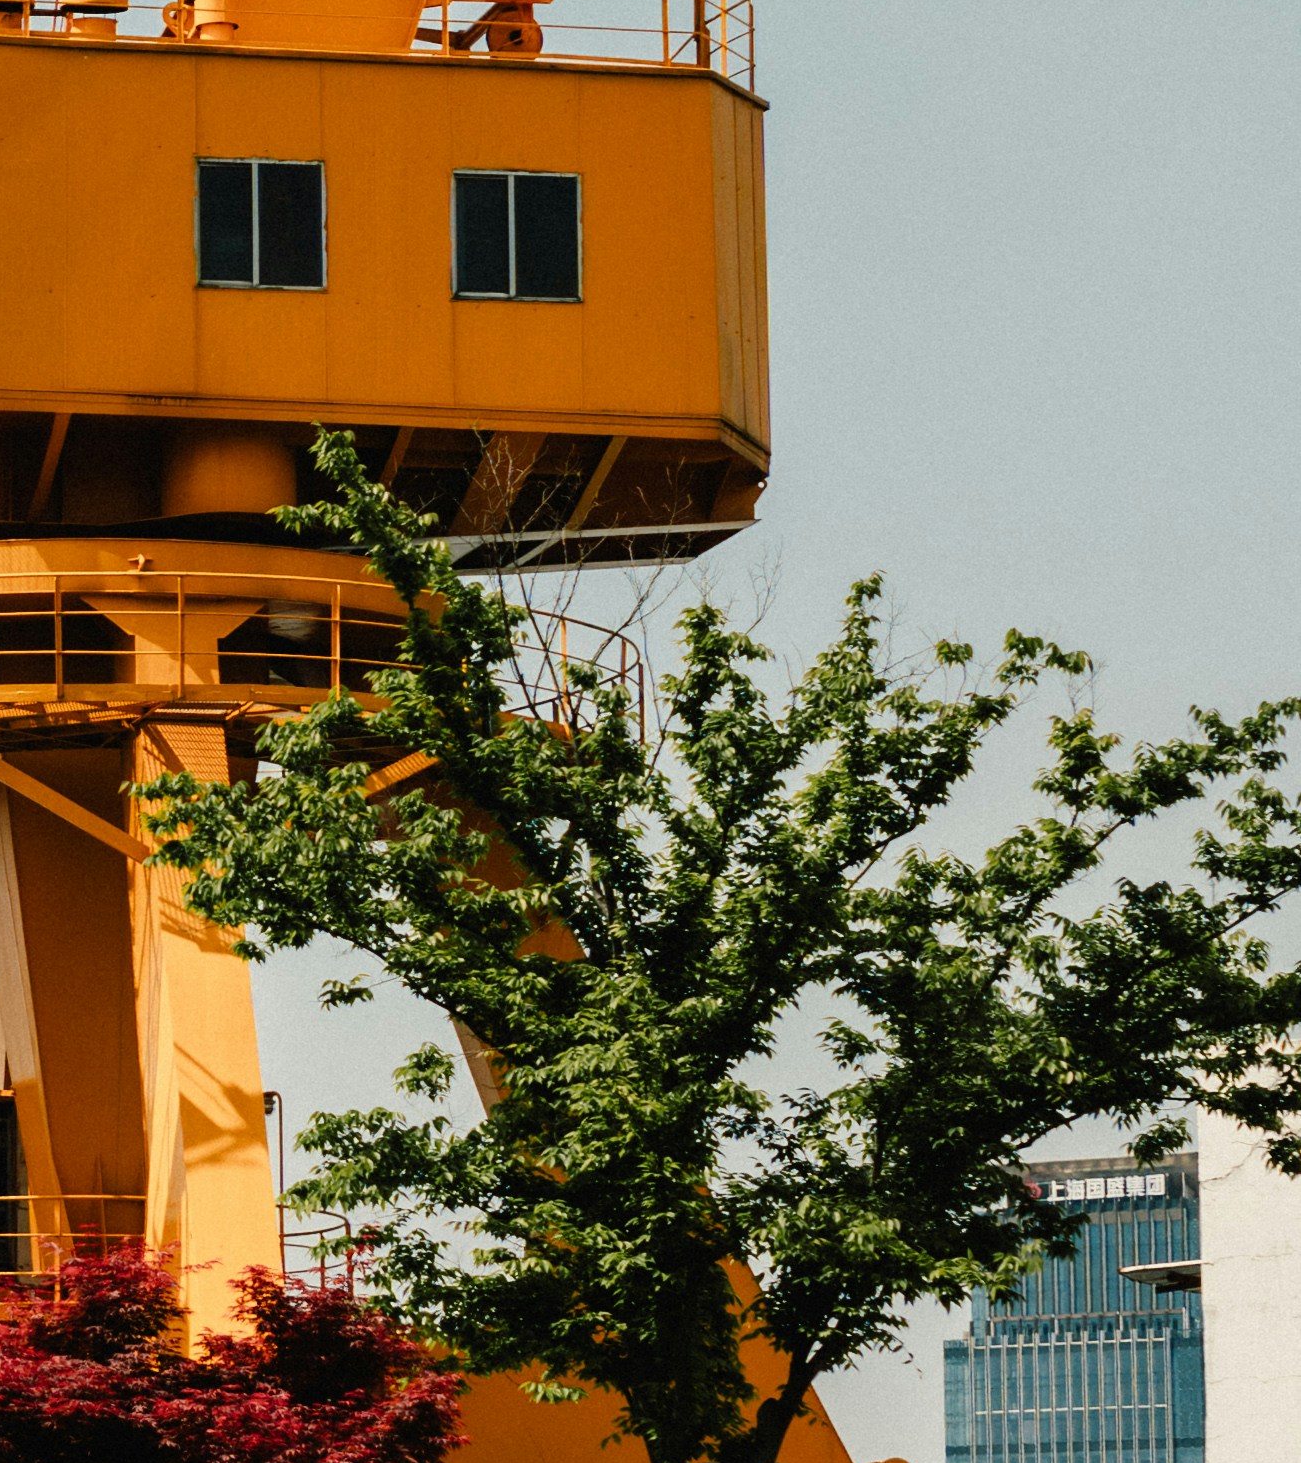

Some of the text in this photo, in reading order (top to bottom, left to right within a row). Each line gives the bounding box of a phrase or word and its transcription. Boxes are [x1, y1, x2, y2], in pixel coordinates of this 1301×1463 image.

[1047, 1174, 1165, 1201] 上海国盛集团
